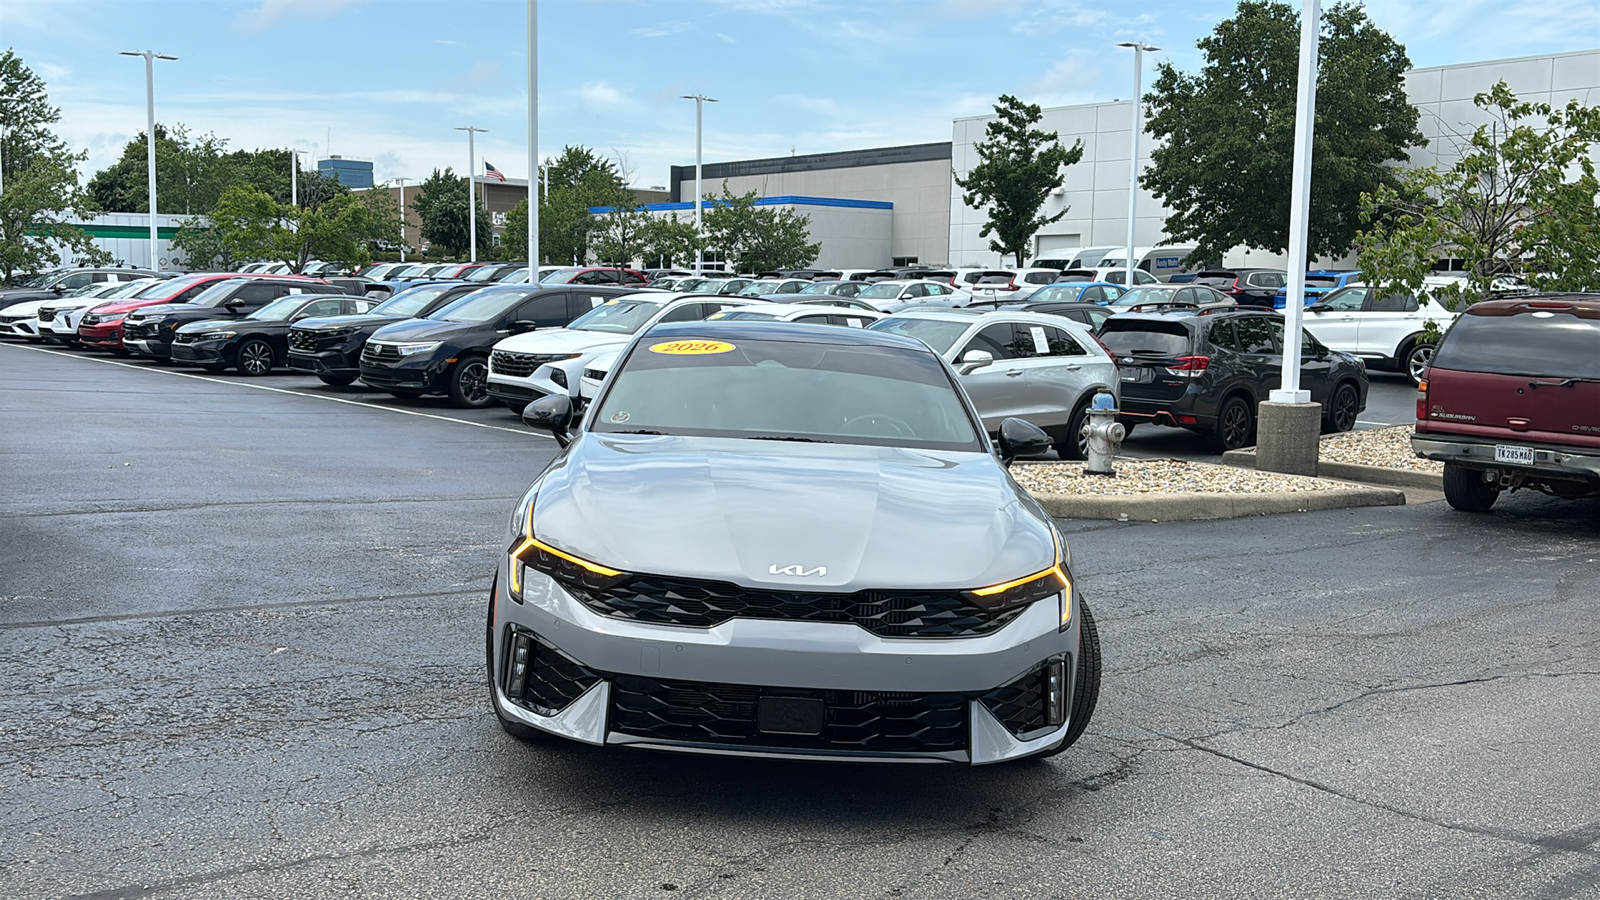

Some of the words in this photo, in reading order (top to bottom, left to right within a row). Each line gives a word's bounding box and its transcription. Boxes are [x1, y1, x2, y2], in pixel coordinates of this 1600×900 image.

[1157, 259, 1167, 268] Andy
[663, 343, 723, 352] 2026
[1438, 412, 1476, 421] SUBURBAN
[769, 563, 827, 577] KIA
